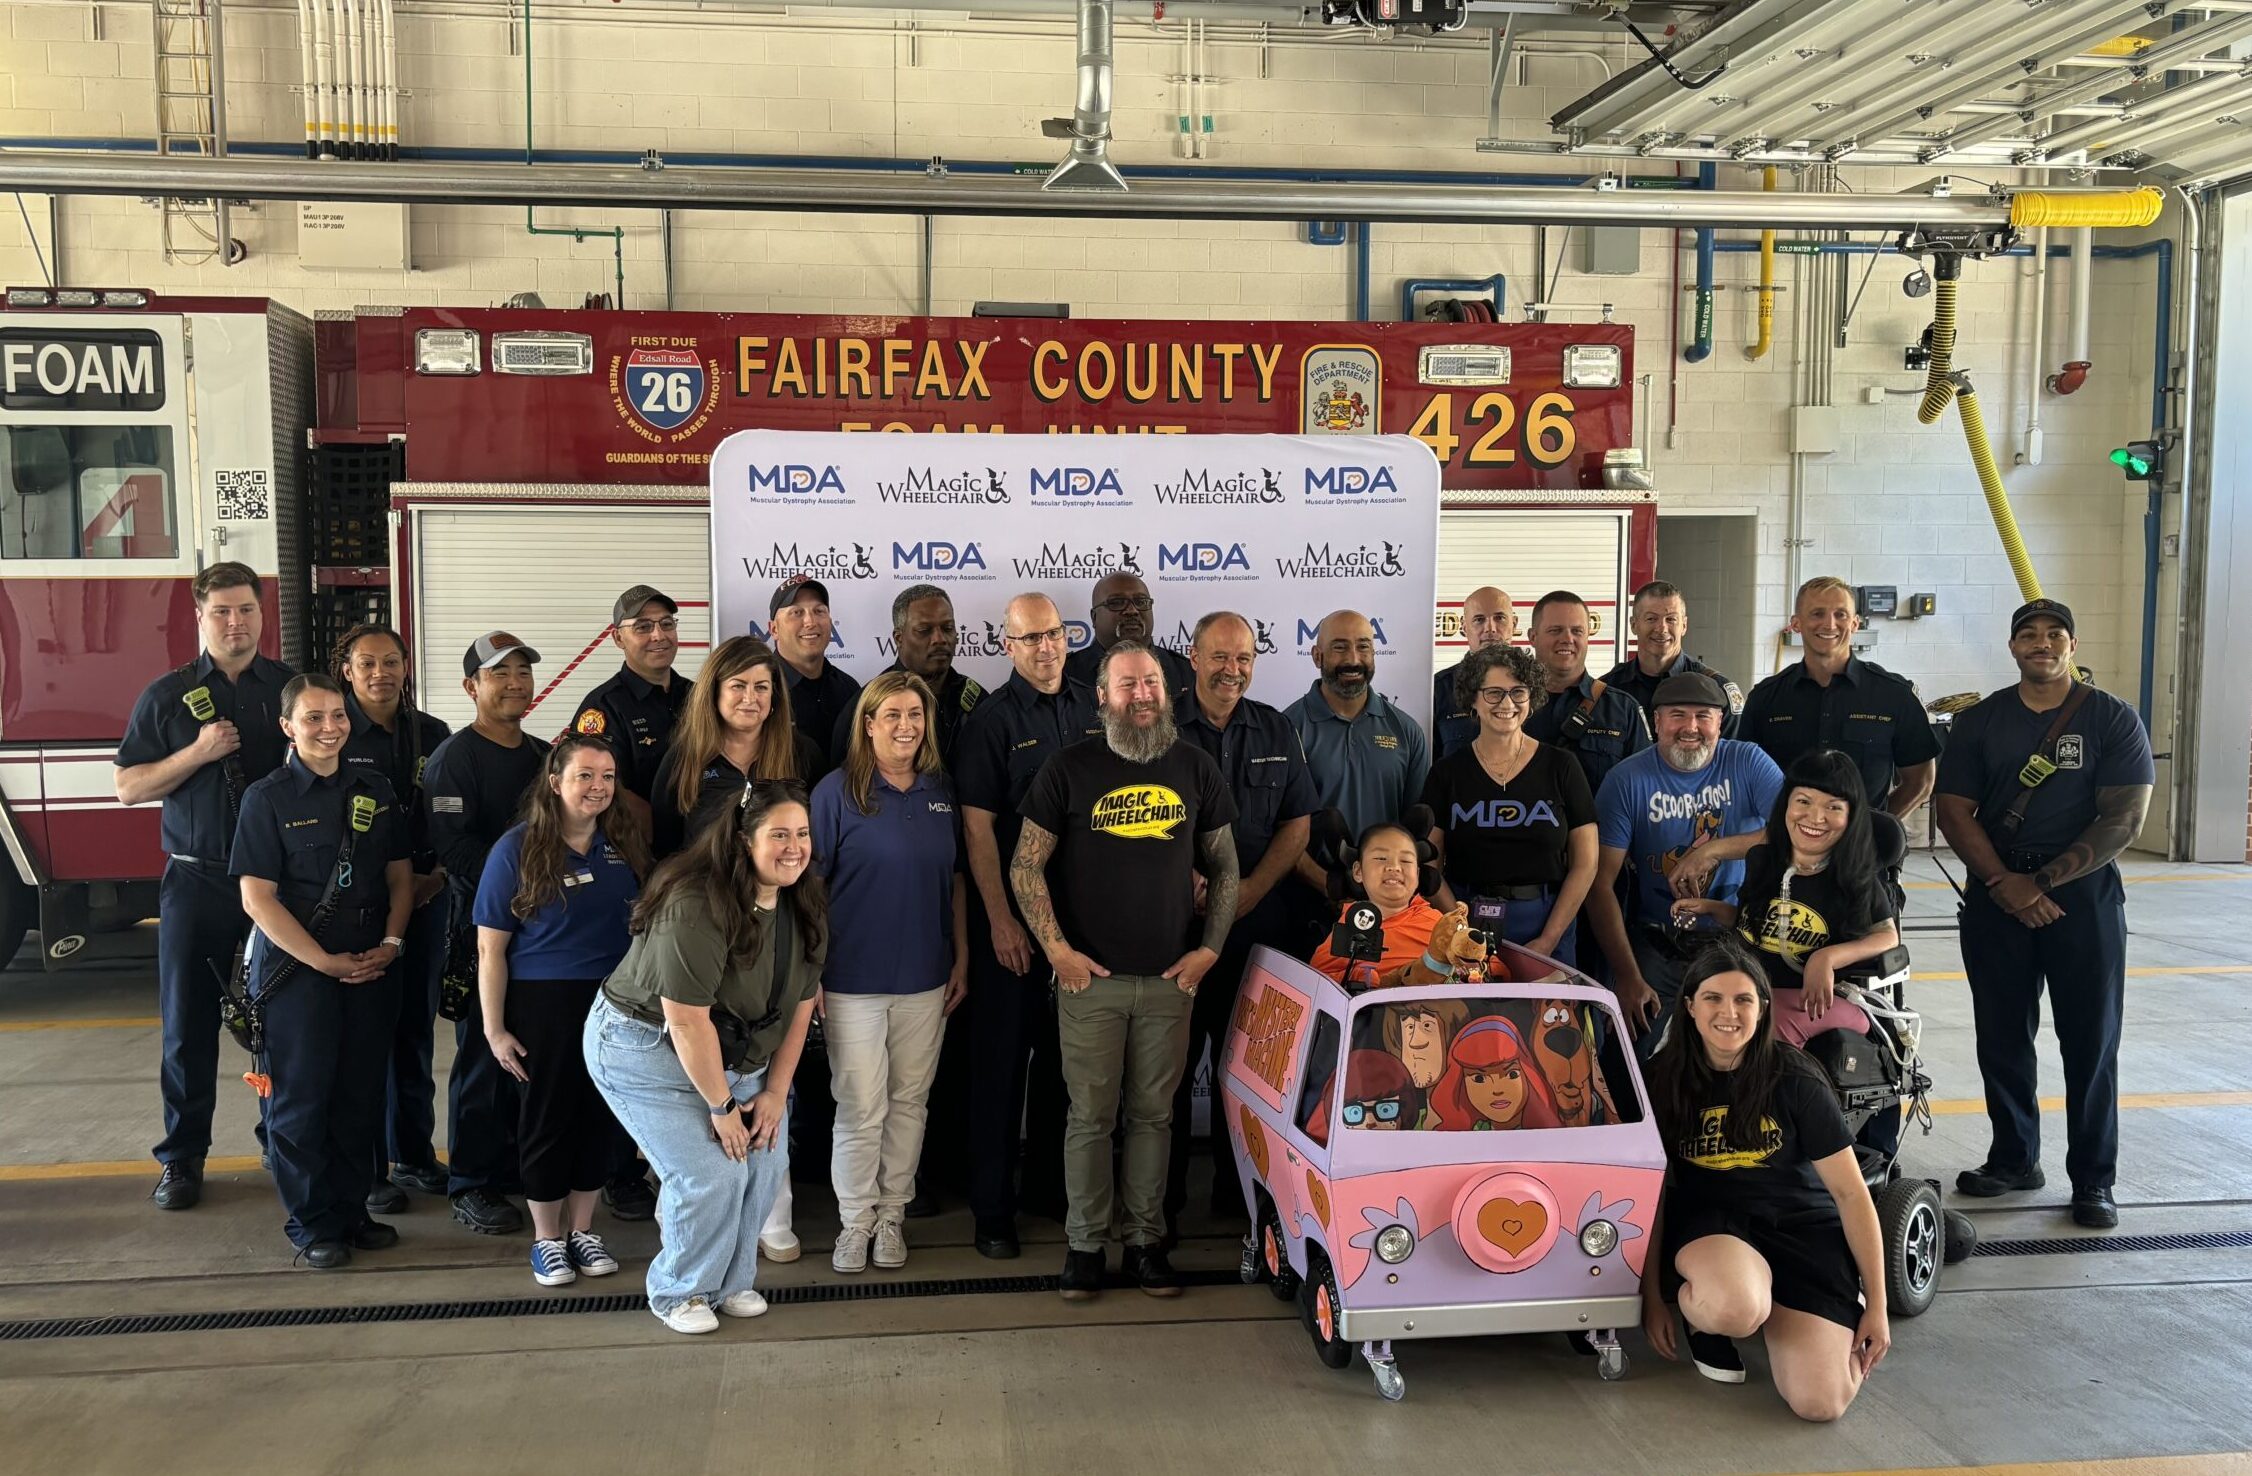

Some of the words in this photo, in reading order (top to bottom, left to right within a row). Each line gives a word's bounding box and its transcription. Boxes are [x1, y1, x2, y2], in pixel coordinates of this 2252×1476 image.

[1793, 245, 1811, 253] WATER
[1702, 304, 1711, 319] COLD
[1700, 319, 1709, 338] WATER
[631, 336, 667, 346] FIRST
[671, 337, 697, 347] DUE
[4, 343, 155, 395] FOAM
[639, 354, 667, 363] Edsall
[669, 355, 691, 363] Road
[737, 336, 992, 400] FAIRFAX
[1309, 363, 1329, 379] FIRE
[1339, 361, 1374, 378] RESCUE
[609, 355, 622, 395] WHERE
[1031, 340, 1284, 403] COUNTY
[1313, 370, 1370, 386] DEPARTMENT
[641, 372, 692, 413] 26
[704, 358, 721, 413] THROUGH
[613, 396, 630, 418] THE
[626, 416, 662, 443] WORLD
[670, 414, 708, 443] PASSES
[1406, 392, 1576, 467] 426
[605, 453, 664, 464] GUARDIANS
[666, 454, 679, 464] OF
[681, 454, 700, 464] THE
[748, 464, 845, 493] MDA
[905, 466, 982, 491] MAGIC
[1030, 467, 1123, 495] MDA
[1181, 468, 1257, 492] MAGIC
[1305, 466, 1397, 494] MDA
[783, 497, 816, 505] Dystrophy
[876, 482, 985, 503] WHEELCHAIR
[1063, 500, 1095, 508] Dystrophy
[1153, 484, 1260, 504] WHEELCHAIR
[1336, 498, 1368, 506] Dystrophy
[771, 542, 848, 567] MAGIC
[892, 541, 986, 570] MDA
[1040, 542, 1115, 567] MAGIC
[1159, 543, 1250, 571] MDA
[1304, 542, 1377, 566] MAGIC
[1275, 558, 1381, 578] WHEELCHAIR
[1297, 617, 1387, 645] MA
[928, 801, 953, 814] MDA
[1098, 790, 1153, 812] MAGIC
[1091, 804, 1185, 829] WHEELCHAIR
[1451, 800, 1559, 831] MDA
